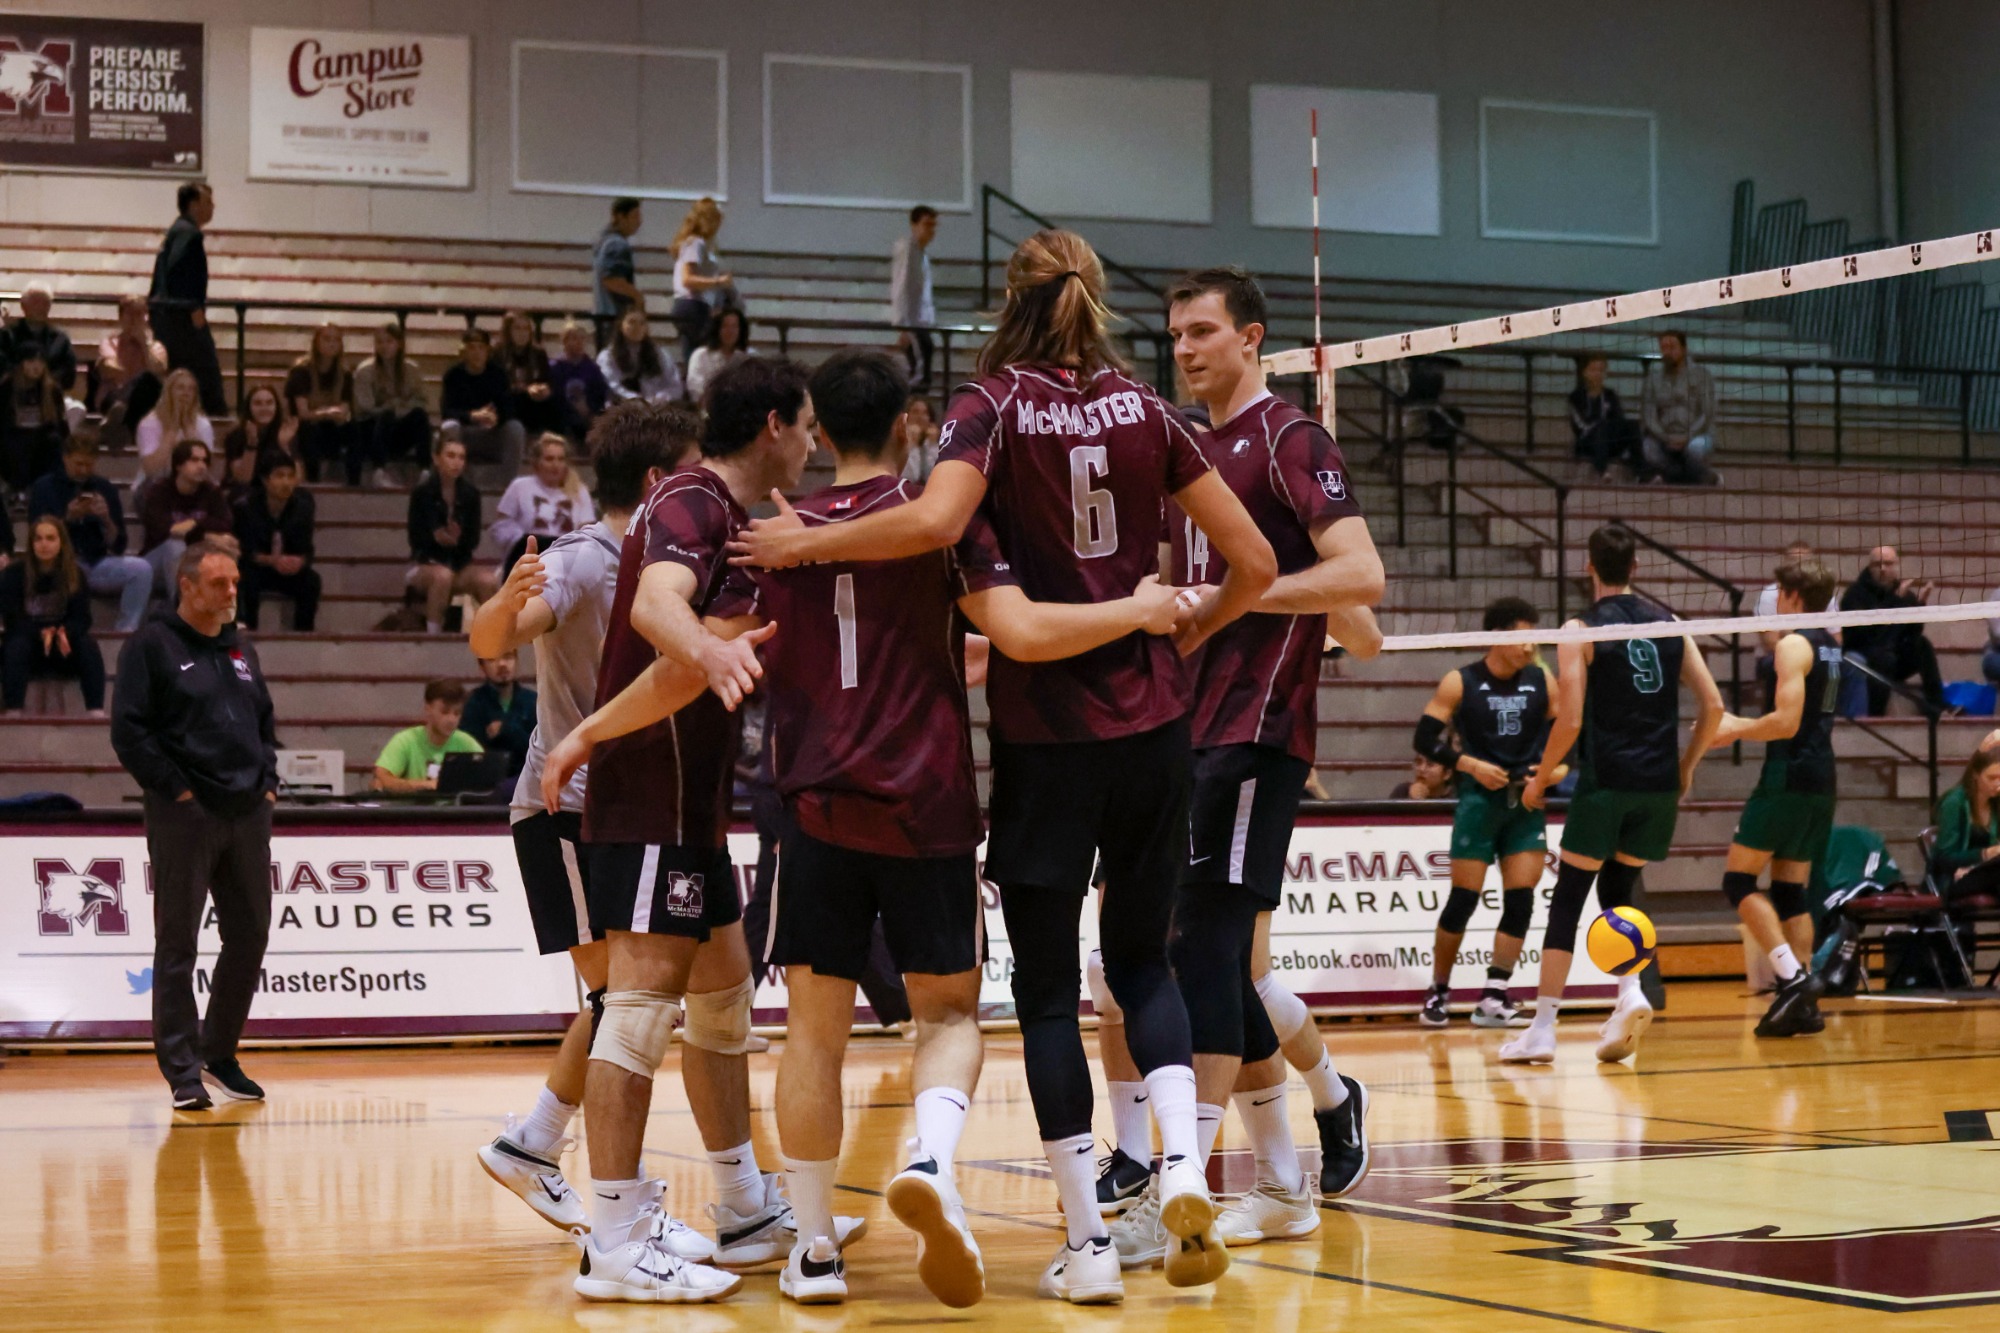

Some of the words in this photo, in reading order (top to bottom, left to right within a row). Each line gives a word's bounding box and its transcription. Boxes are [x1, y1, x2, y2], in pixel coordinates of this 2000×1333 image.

[89, 46, 186, 70] PREPARE.
[89, 69, 177, 92] PERSIST.
[288, 38, 423, 98] Campus
[89, 90, 192, 114] PERFORM.
[343, 80, 415, 118] Store
[1016, 391, 1146, 438] McMASTER
[1069, 445, 1119, 559] 6
[1184, 515, 1209, 583] 14
[833, 573, 858, 690] 1
[1627, 638, 1664, 693] 9
[1497, 710, 1522, 735] 15
